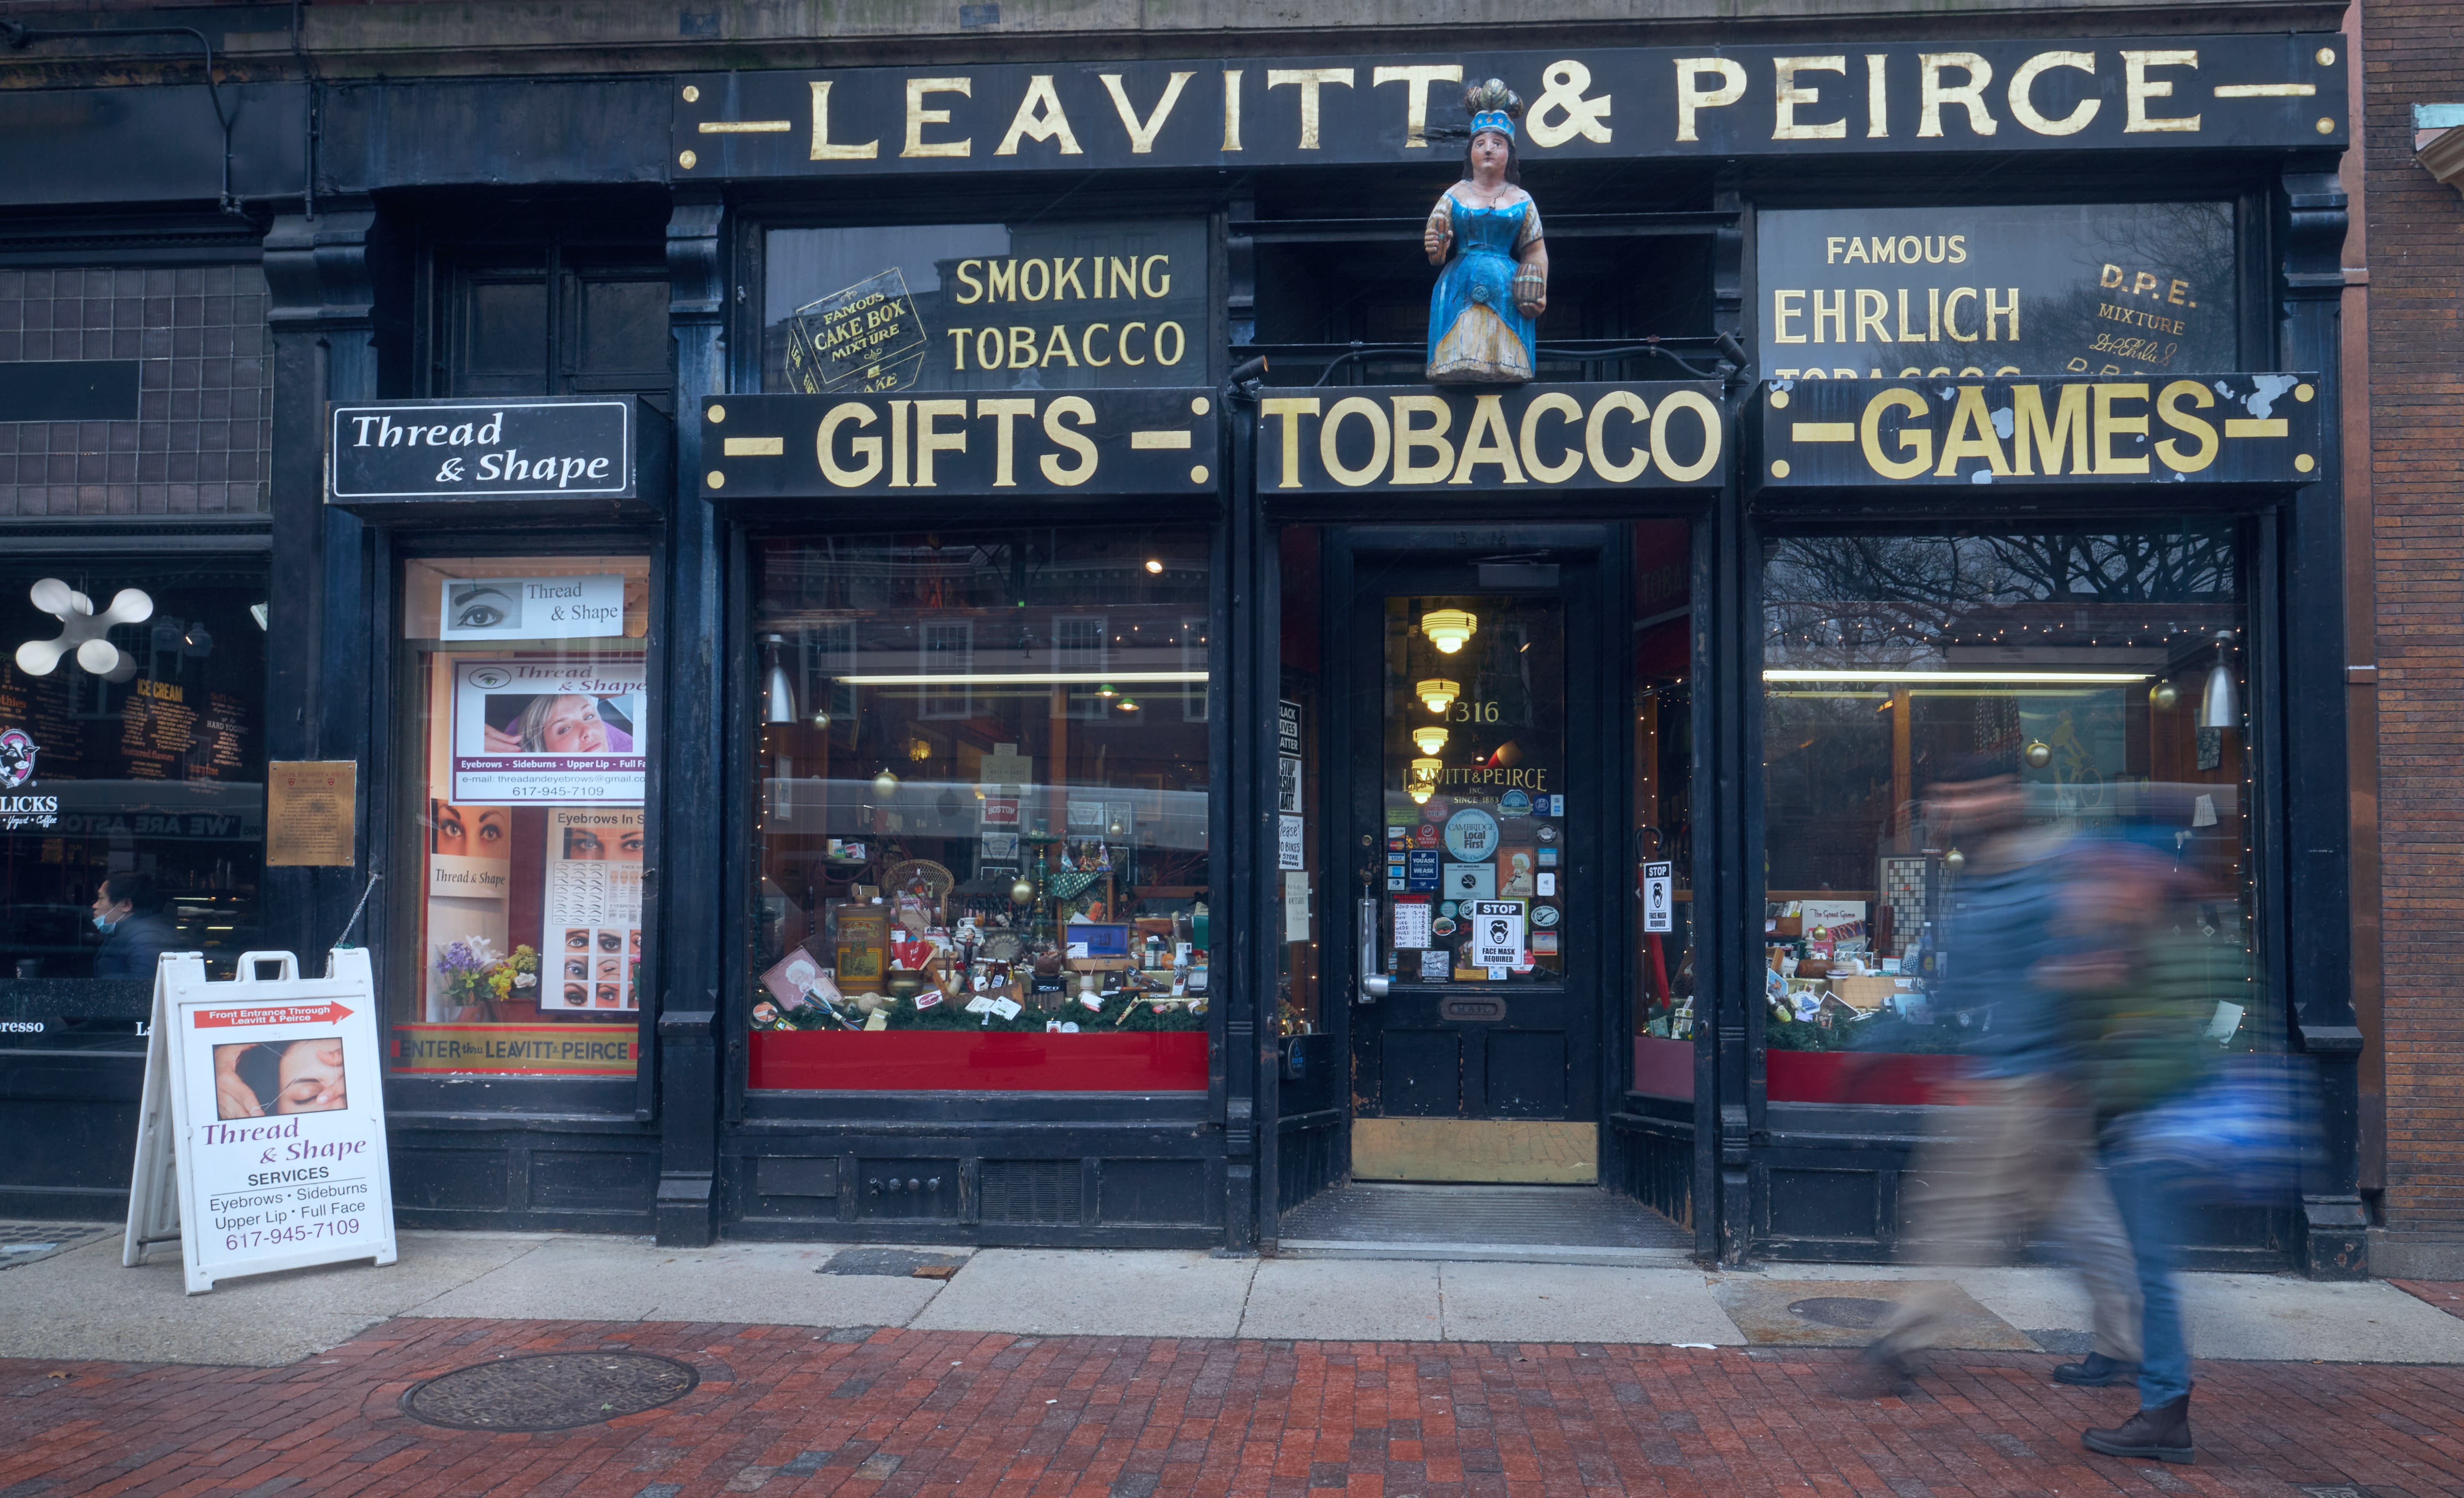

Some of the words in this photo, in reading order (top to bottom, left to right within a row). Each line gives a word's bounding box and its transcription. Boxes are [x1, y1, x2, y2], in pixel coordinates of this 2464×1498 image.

[809, 64, 1463, 160] LEAVITT
[1525, 59, 1612, 148] &
[1673, 49, 2201, 143] PEIRCE
[1826, 235, 1967, 265] FAMOUS
[956, 254, 1170, 304] SMOKING
[2100, 263, 2198, 309] D.P.E.
[823, 292, 885, 325] FAMOUS
[1774, 286, 2021, 344] EHRLICH
[814, 317, 863, 351] CAKE
[867, 298, 906, 329] BOX
[2098, 303, 2186, 336] MIXTURE
[832, 323, 900, 362] MIXTURE
[948, 321, 1186, 370] TOBACCO
[862, 373, 898, 393] AKE
[352, 412, 504, 447] Thread
[1860, 380, 2219, 479] GAMES
[816, 396, 1099, 488] GIFTS
[1261, 390, 1722, 488] TOBACCO
[435, 457, 466, 482] &
[475, 449, 610, 488] Shape
[526, 581, 582, 599] Thread
[551, 606, 566, 621] &
[571, 605, 618, 624] Shape
[515, 666, 593, 679] Thread
[137, 678, 151, 696] ICE
[153, 681, 183, 702] CREAM
[558, 682, 574, 691] &
[578, 679, 647, 695] Shape
[1279, 706, 1296, 720] LACK
[1445, 700, 1499, 723] 1316
[207, 720, 224, 730] HARD
[1280, 736, 1298, 750] ATTER
[461, 760, 503, 770] Eyebrows
[512, 760, 557, 769] Sideburns
[567, 760, 594, 770] Upper
[595, 760, 610, 770] Lip
[619, 760, 635, 768] Full
[1280, 759, 1296, 776] STOP
[462, 774, 495, 783] e-mail:
[1401, 768, 1472, 793] LEAVITT
[1472, 771, 1481, 784] &
[1483, 768, 1548, 792] PEIRCE
[512, 787, 604, 796] 617-945-7109
[1454, 796, 1478, 804] SINCE
[1482, 796, 1499, 804] 1883
[0, 796, 58, 813] LICKS
[988, 805, 1015, 815] BOSTON
[1280, 792, 1295, 811] HATE
[7, 815, 29, 830] Yogurt
[36, 814, 57, 827] Coffee
[558, 812, 618, 825] Eyebrows
[621, 814, 633, 824] In
[1456, 810, 1486, 819] Independent
[1447, 823, 1495, 832] CAMBRIDGE
[1464, 830, 1486, 839] Local
[1285, 842, 1301, 853] BIKES
[1464, 840, 1484, 849] First
[435, 869, 469, 884] Thread
[470, 874, 478, 883] &
[479, 872, 505, 886] Shape
[1648, 866, 1667, 876] STOP
[1483, 905, 1517, 914] STOP
[1810, 908, 1822, 917] The
[1823, 910, 1839, 920] Great
[1840, 910, 1856, 920] Game
[1482, 947, 1499, 956] FACE
[1484, 955, 1513, 963] REQUIRED
[209, 1011, 238, 1020] Front
[240, 1009, 286, 1018] Entrance
[288, 1006, 331, 1016] Through
[1457, 1005, 1491, 1013] MAIL
[231, 1016, 267, 1026] Leavitt
[279, 1013, 311, 1022] Peirce
[400, 1040, 460, 1058] ENTER
[462, 1041, 485, 1055] thru
[485, 1041, 553, 1059] LEAVITT
[562, 1041, 628, 1060] PEIRCE
[201, 1117, 299, 1146] Thread
[260, 1147, 279, 1164] &
[286, 1138, 367, 1162] Shape
[248, 1166, 329, 1186] SERVICES
[210, 1192, 283, 1214] Eyebrows
[297, 1182, 368, 1201] Sideburns
[215, 1214, 260, 1231] Upper
[265, 1210, 287, 1224] Lip
[301, 1203, 327, 1218] Full
[331, 1201, 366, 1214] Face
[226, 1218, 360, 1250] 617-945-7109
